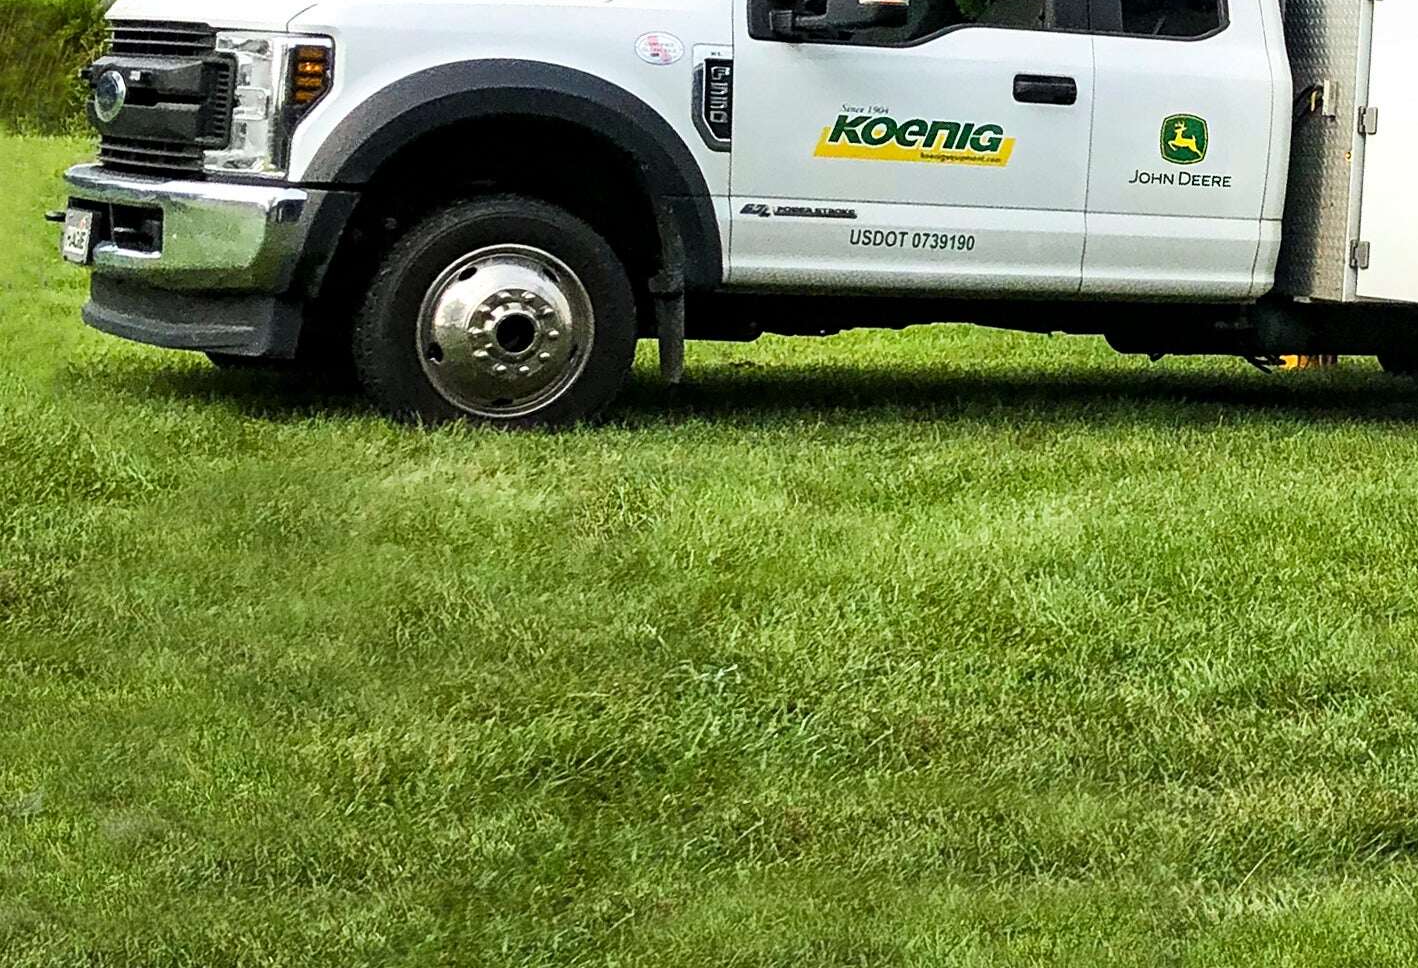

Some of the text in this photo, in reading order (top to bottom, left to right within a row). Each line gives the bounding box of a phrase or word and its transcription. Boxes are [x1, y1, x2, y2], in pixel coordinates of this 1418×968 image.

[867, 105, 889, 115] 1904
[1128, 169, 1232, 188] JOHN DEERE
[849, 229, 975, 251] USDOT 0739190
